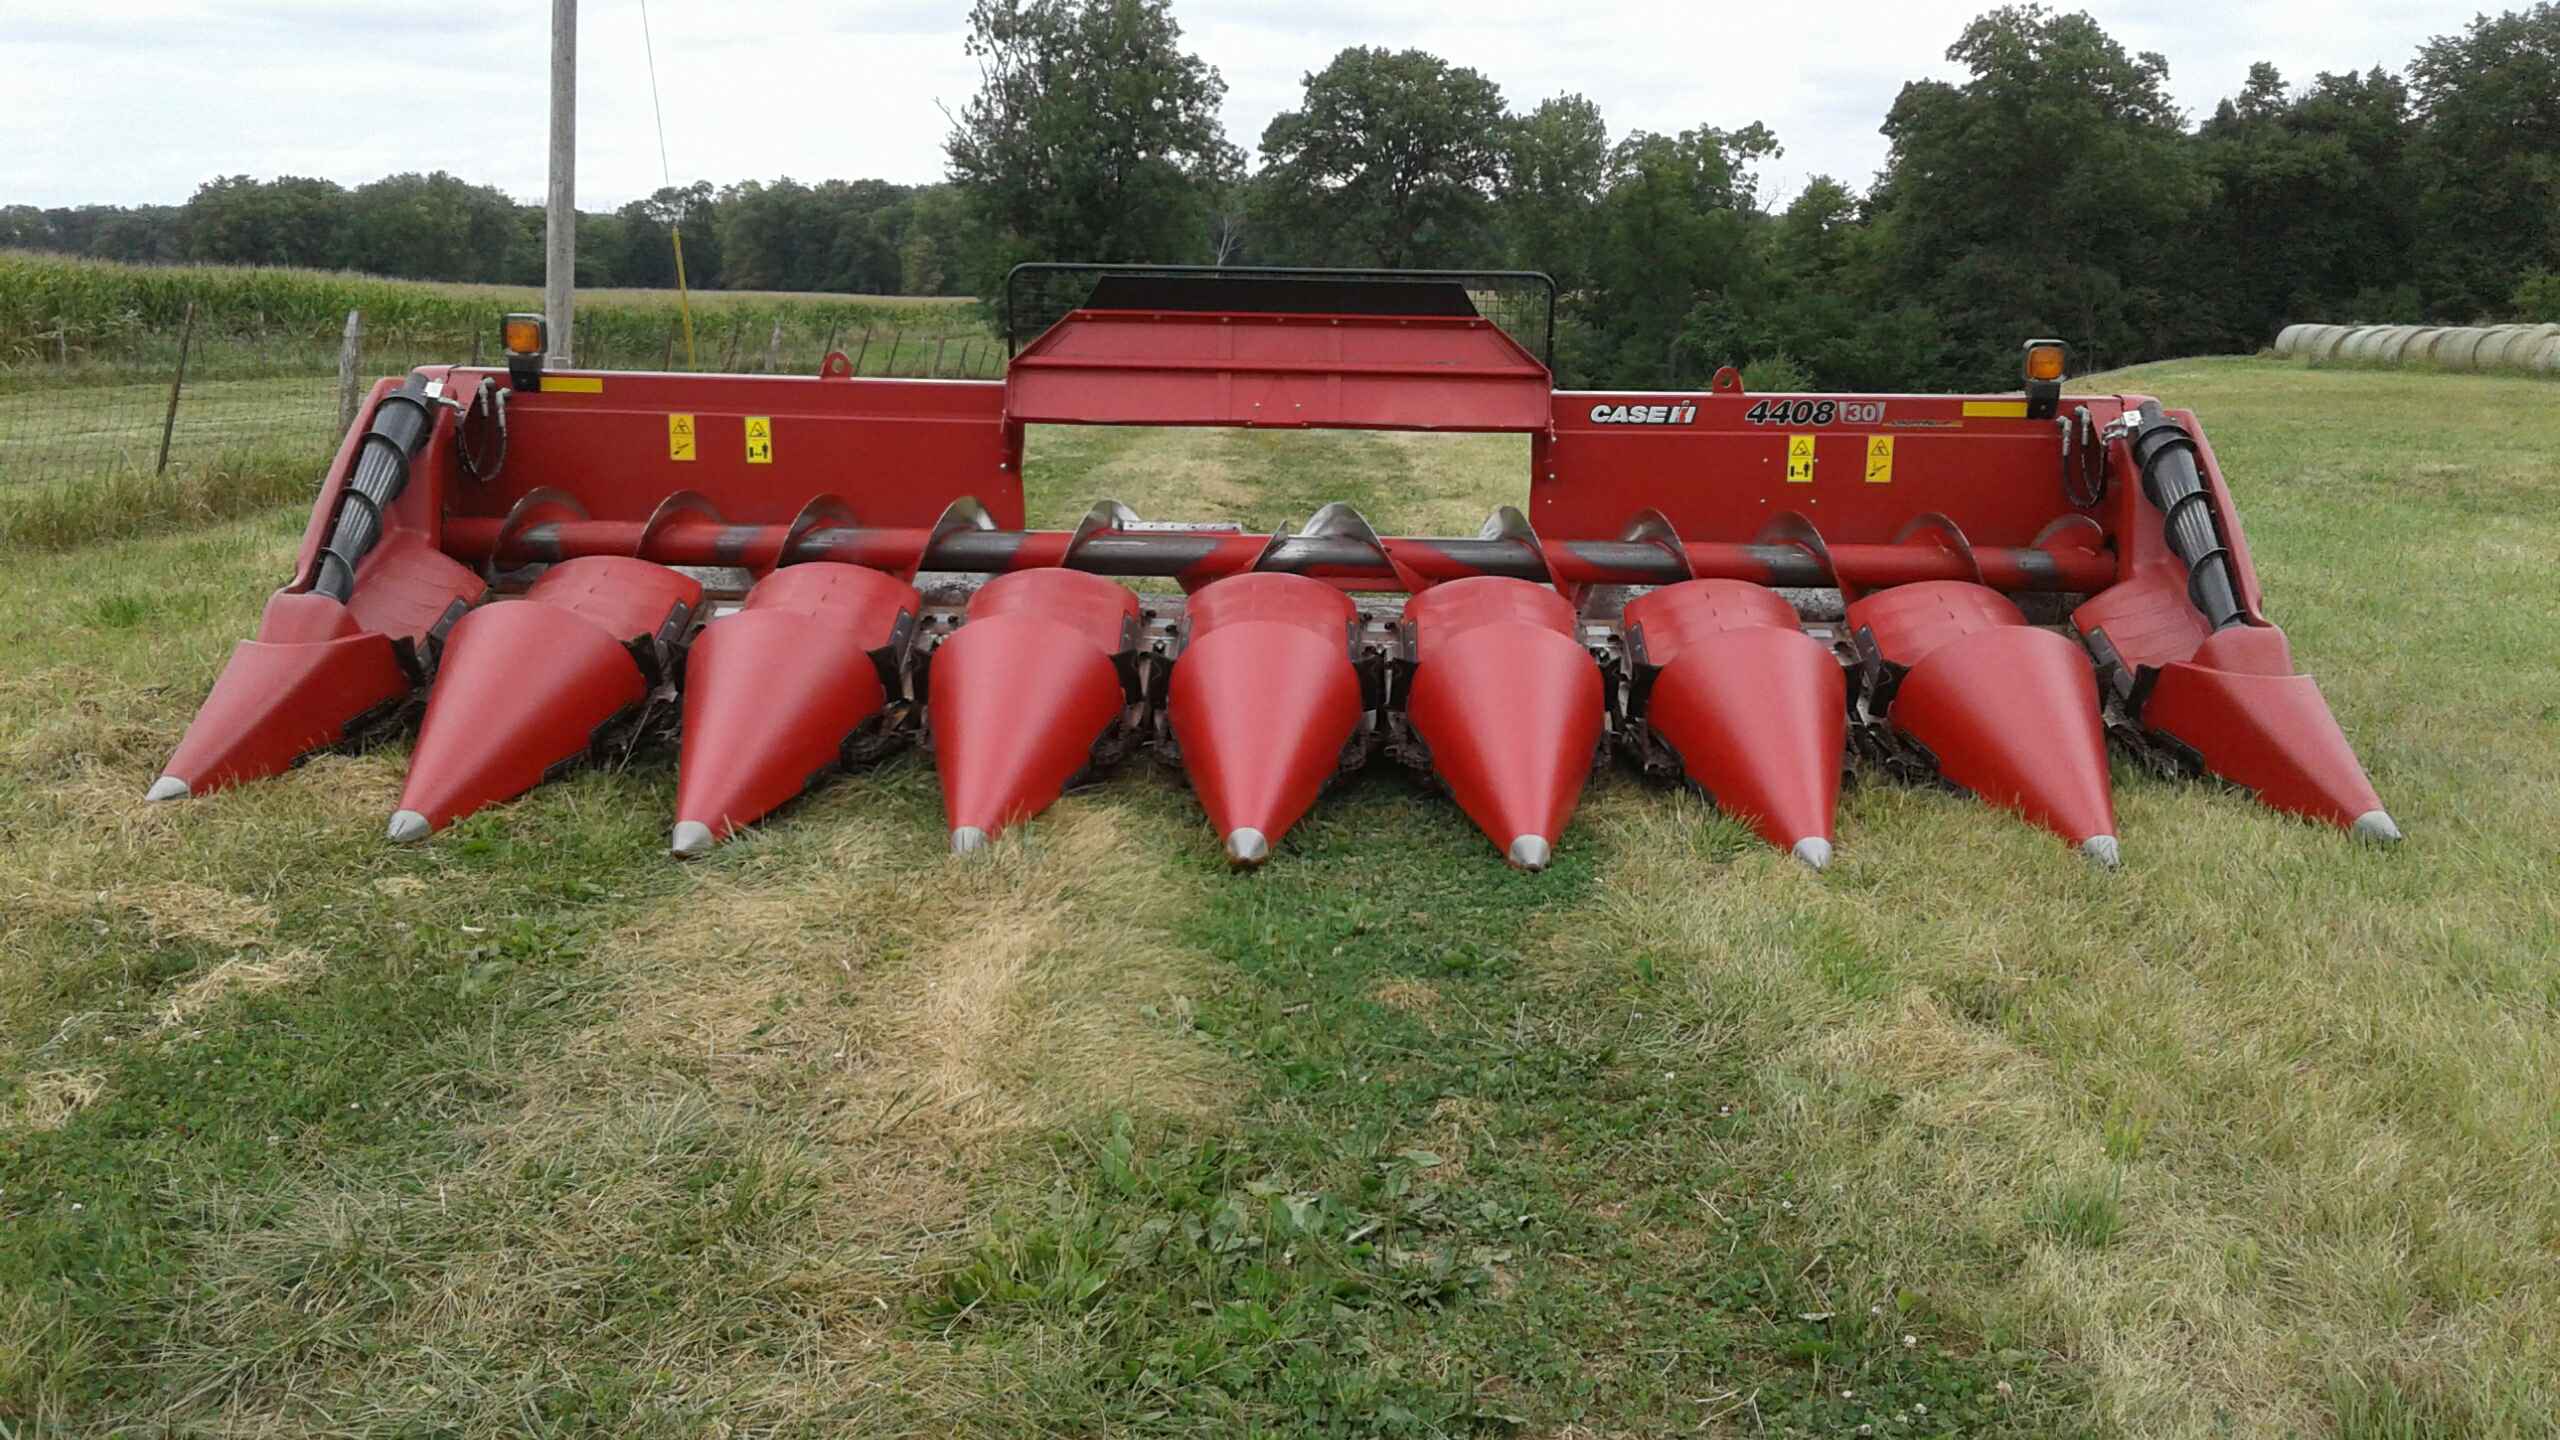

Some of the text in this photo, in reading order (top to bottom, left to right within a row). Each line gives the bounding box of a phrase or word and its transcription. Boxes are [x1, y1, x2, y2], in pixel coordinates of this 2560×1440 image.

[1590, 404, 1668, 423] CASE
[1745, 400, 1877, 426] 4408 30
